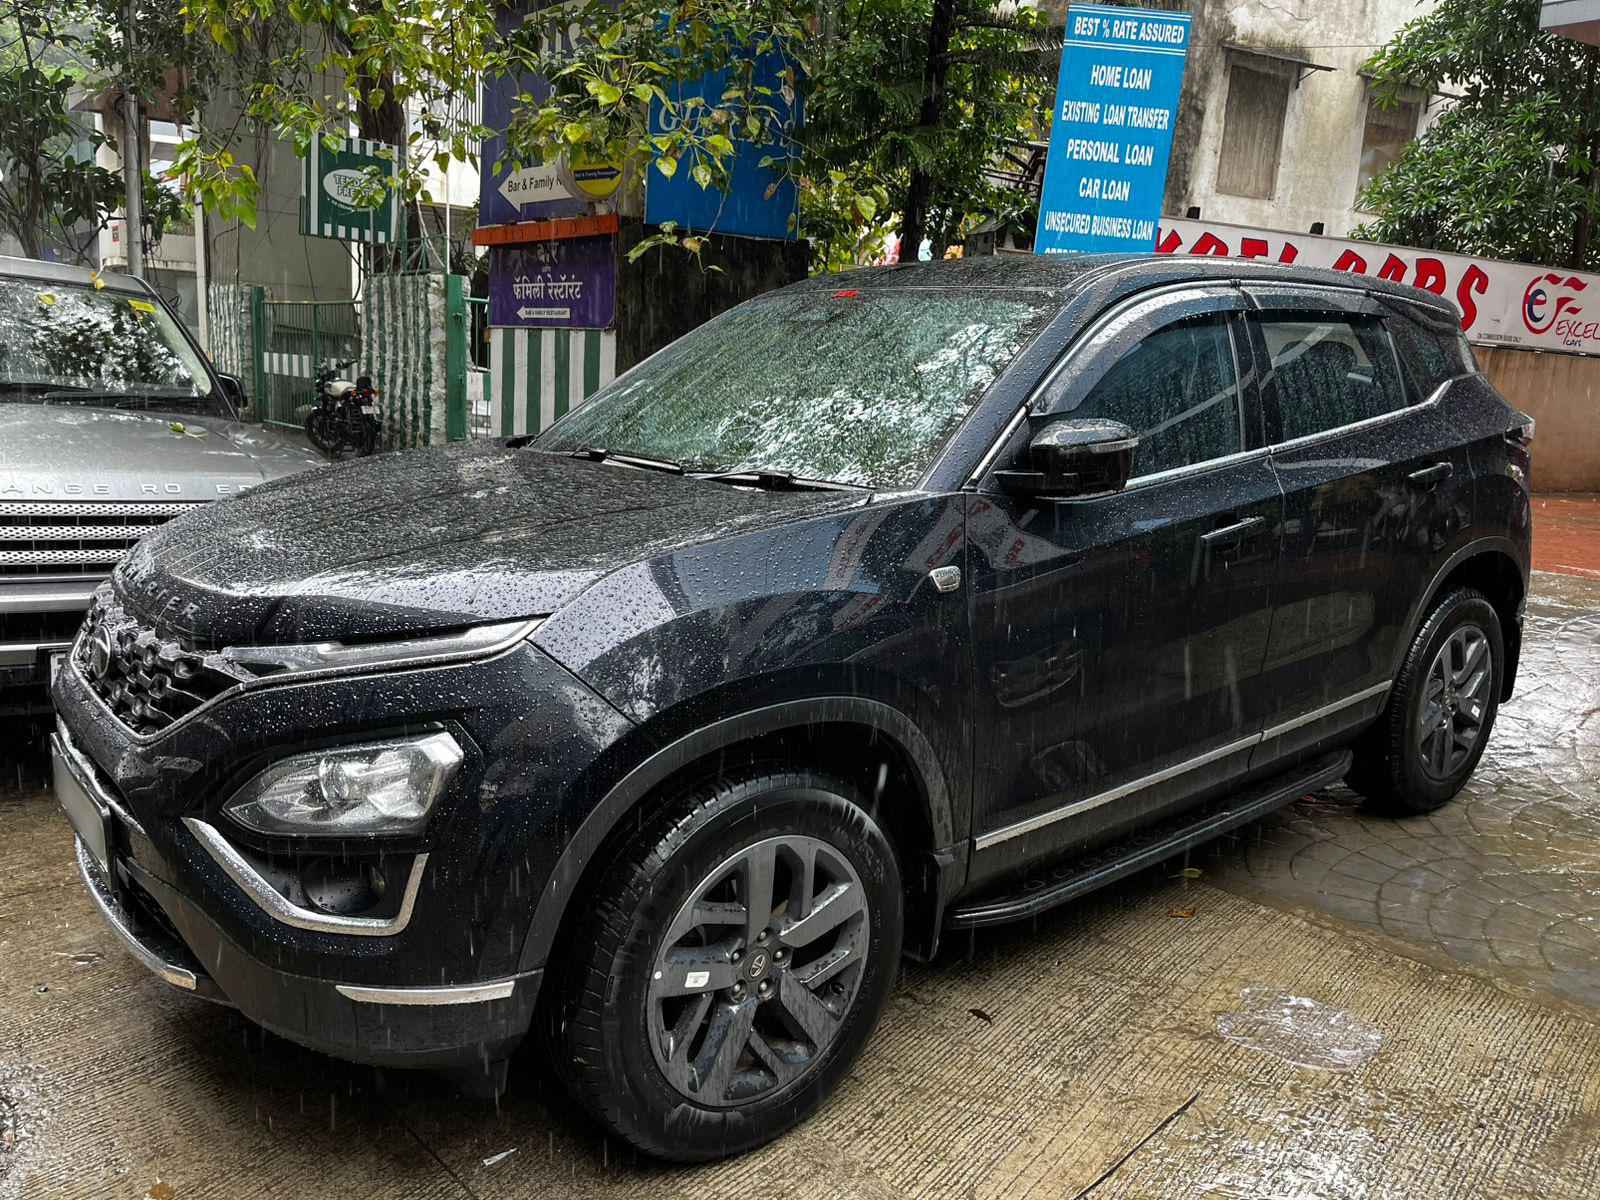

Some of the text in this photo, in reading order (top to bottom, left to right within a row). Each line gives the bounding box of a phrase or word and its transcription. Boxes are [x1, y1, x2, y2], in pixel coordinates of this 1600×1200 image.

[1074, 16, 1185, 44] BEST % RATE ASSURED
[1090, 65, 1152, 91] HOME LOAN
[1061, 100, 1170, 130] EXISTING LOAN TRANSFER
[1066, 138, 1154, 167] PERSONAL LOAN
[507, 180, 521, 193] Bar
[522, 178, 528, 190] &
[529, 175, 554, 191] Family
[1079, 177, 1131, 202] CAR LOAN
[1044, 211, 1091, 235] UNSECURED
[1131, 219, 1154, 241] LOAN
[512, 273, 583, 300] फॅमिली रेस्टॉरंट
